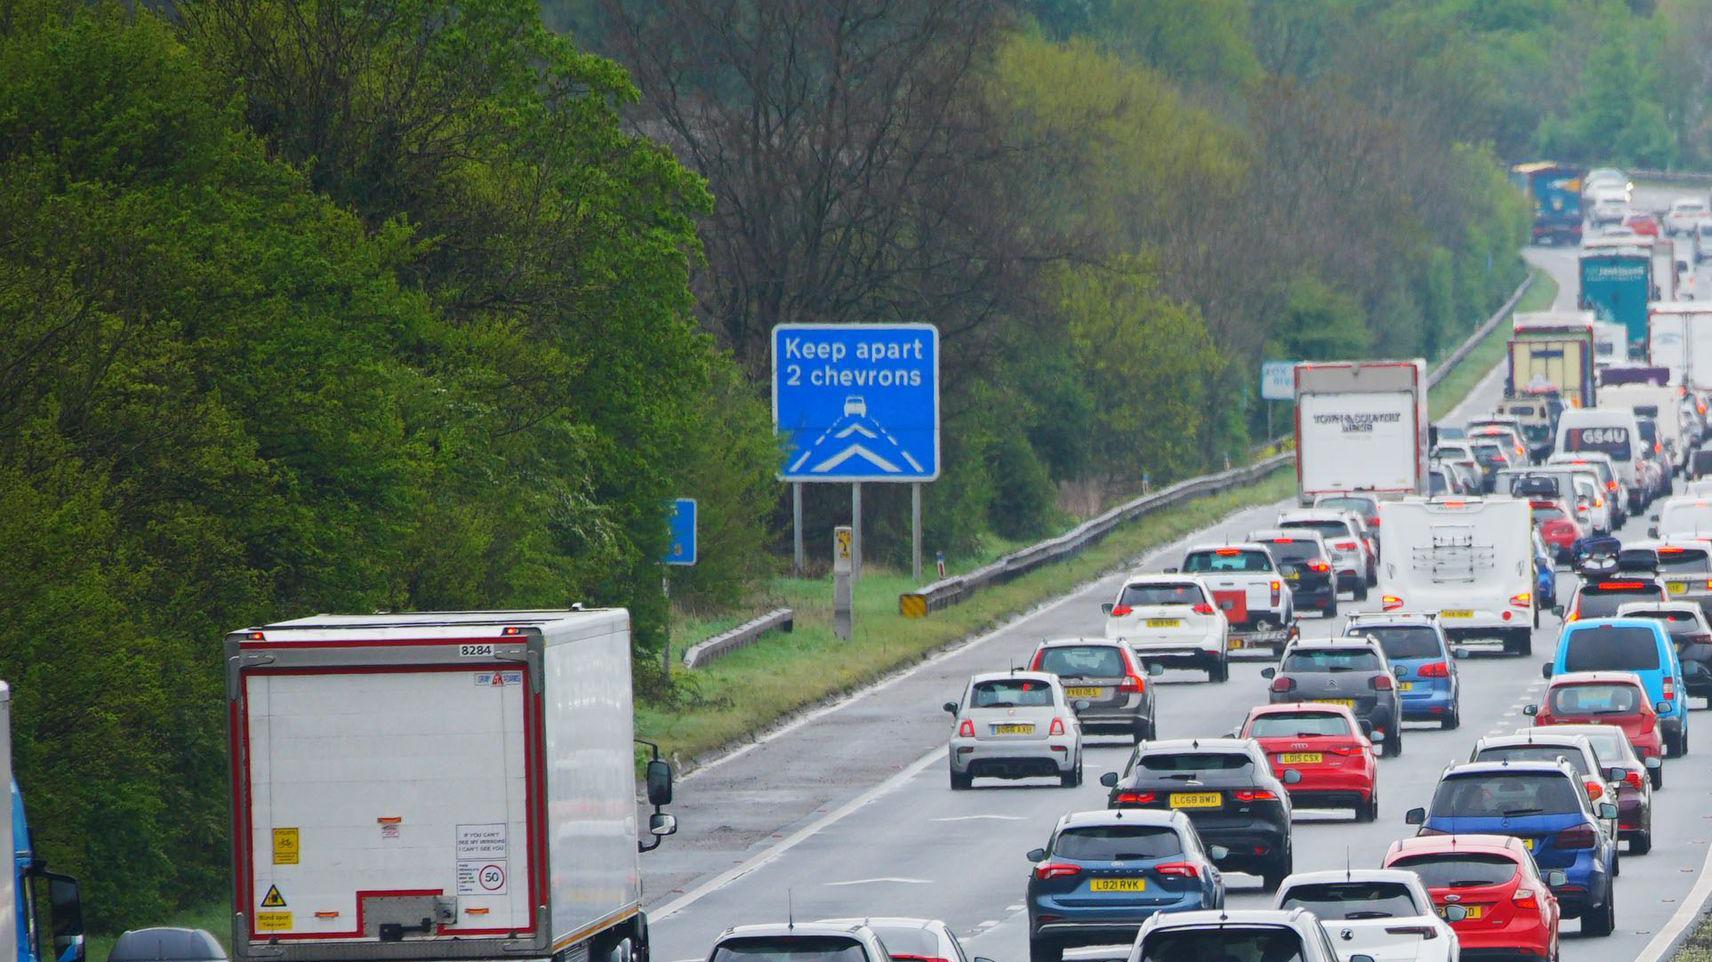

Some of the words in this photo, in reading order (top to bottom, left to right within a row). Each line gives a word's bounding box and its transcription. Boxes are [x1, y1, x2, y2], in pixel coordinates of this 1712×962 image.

[785, 337, 847, 363] Keep
[856, 338, 923, 363] apart
[786, 365, 801, 386] 2
[810, 365, 922, 387] chevrons
[1582, 429, 1626, 444] GS4U
[461, 645, 492, 656] 8284
[485, 872, 499, 883] 50
